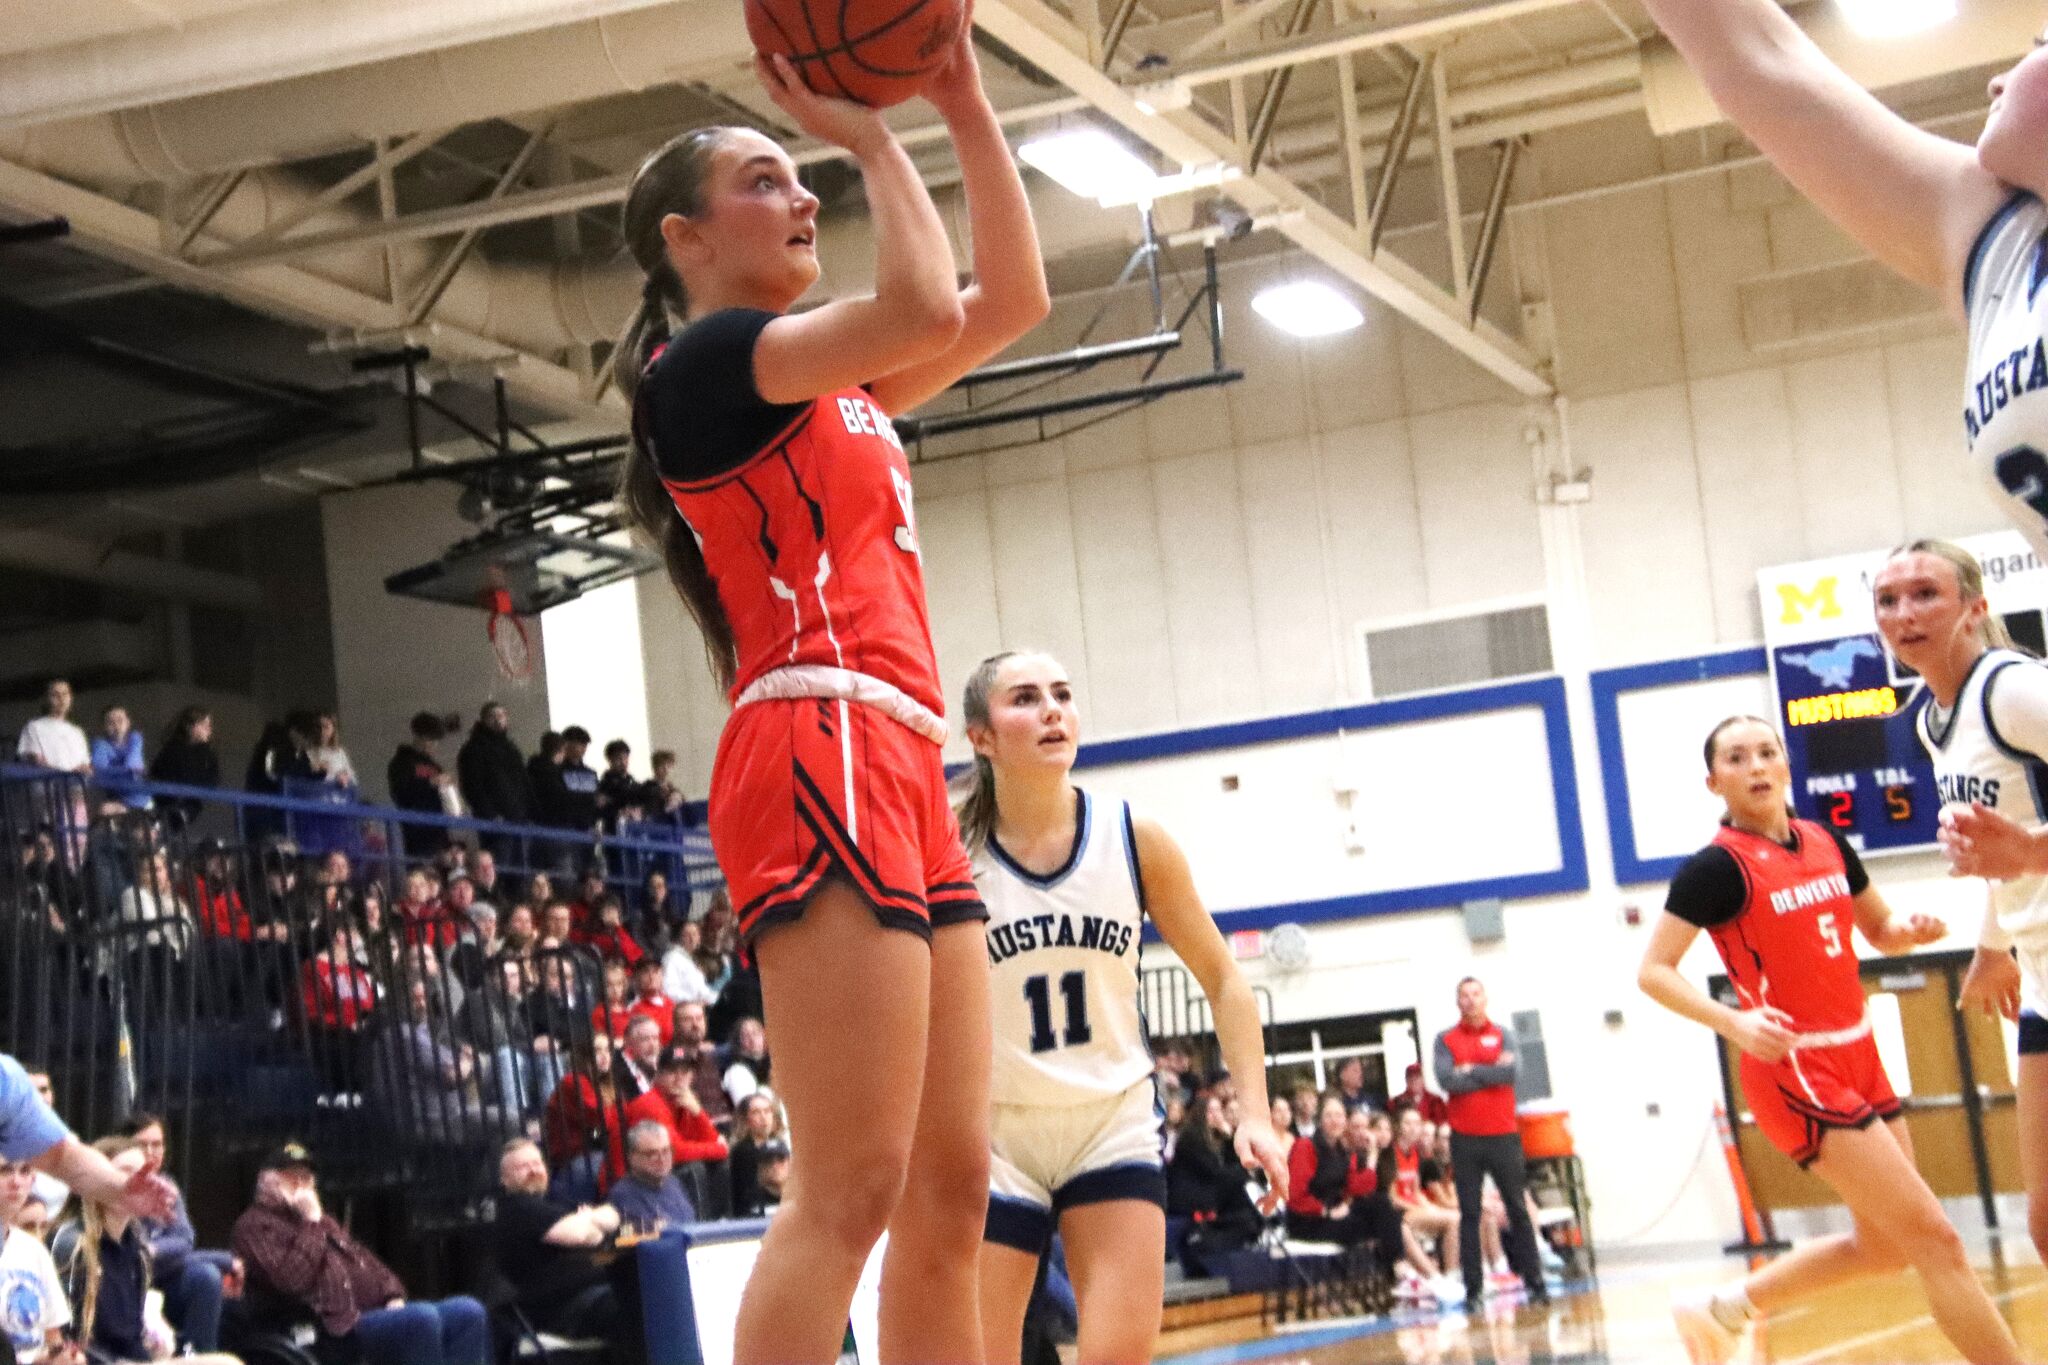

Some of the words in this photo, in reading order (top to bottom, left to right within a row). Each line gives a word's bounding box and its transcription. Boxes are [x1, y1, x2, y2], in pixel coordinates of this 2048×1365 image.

[1776, 576, 1842, 625] M
[1787, 686, 1897, 727] MUSTANGS
[1830, 791, 1853, 827] 2
[1885, 785, 1911, 820] 5
[1769, 872, 1851, 916] BEAVERTO
[1816, 911, 1843, 959] 5
[1023, 969, 1092, 1054] 11
